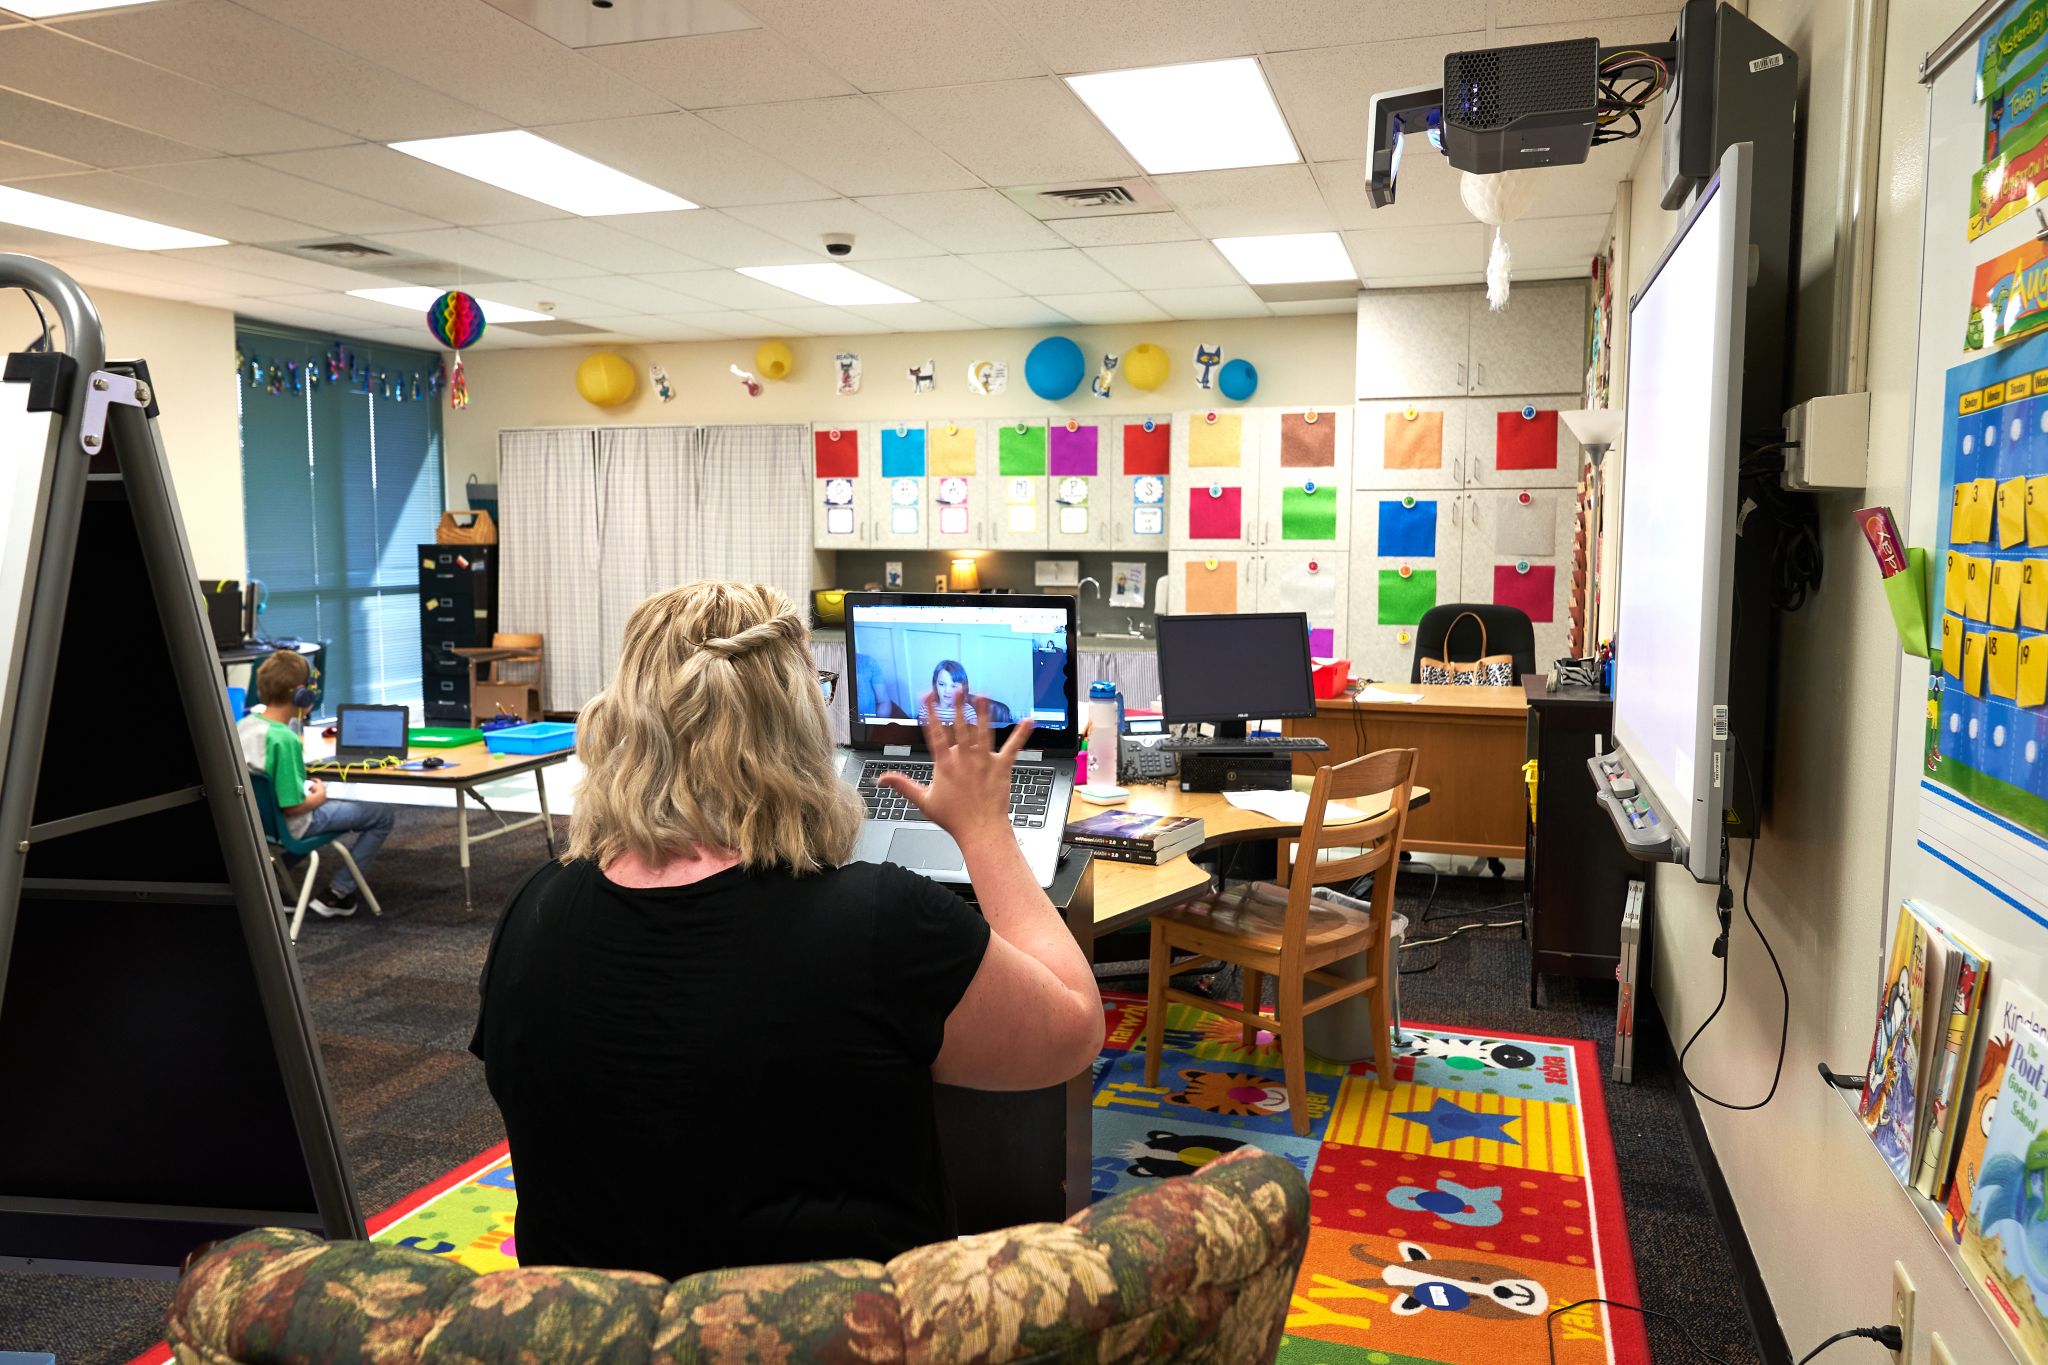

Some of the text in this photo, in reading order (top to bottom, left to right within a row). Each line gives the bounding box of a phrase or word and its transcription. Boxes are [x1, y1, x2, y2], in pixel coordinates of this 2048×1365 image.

[2008, 87, 2037, 120] Today
[1973, 485, 1979, 502] 3
[1999, 489, 2005, 508] 4
[2027, 486, 2034, 505] 5
[1948, 556, 2032, 585] 9 10 11 12
[1943, 618, 2030, 665] 16 17 18 19
[1536, 1055, 1569, 1086] zebra
[2011, 1040, 2048, 1099] Pout-
[1092, 1082, 1170, 1109] Tt
[2008, 1072, 2038, 1111] Goes to
[2011, 1100, 2038, 1133] School
[1285, 1273, 1389, 1330] Yy
[1549, 1298, 1603, 1341] yak
